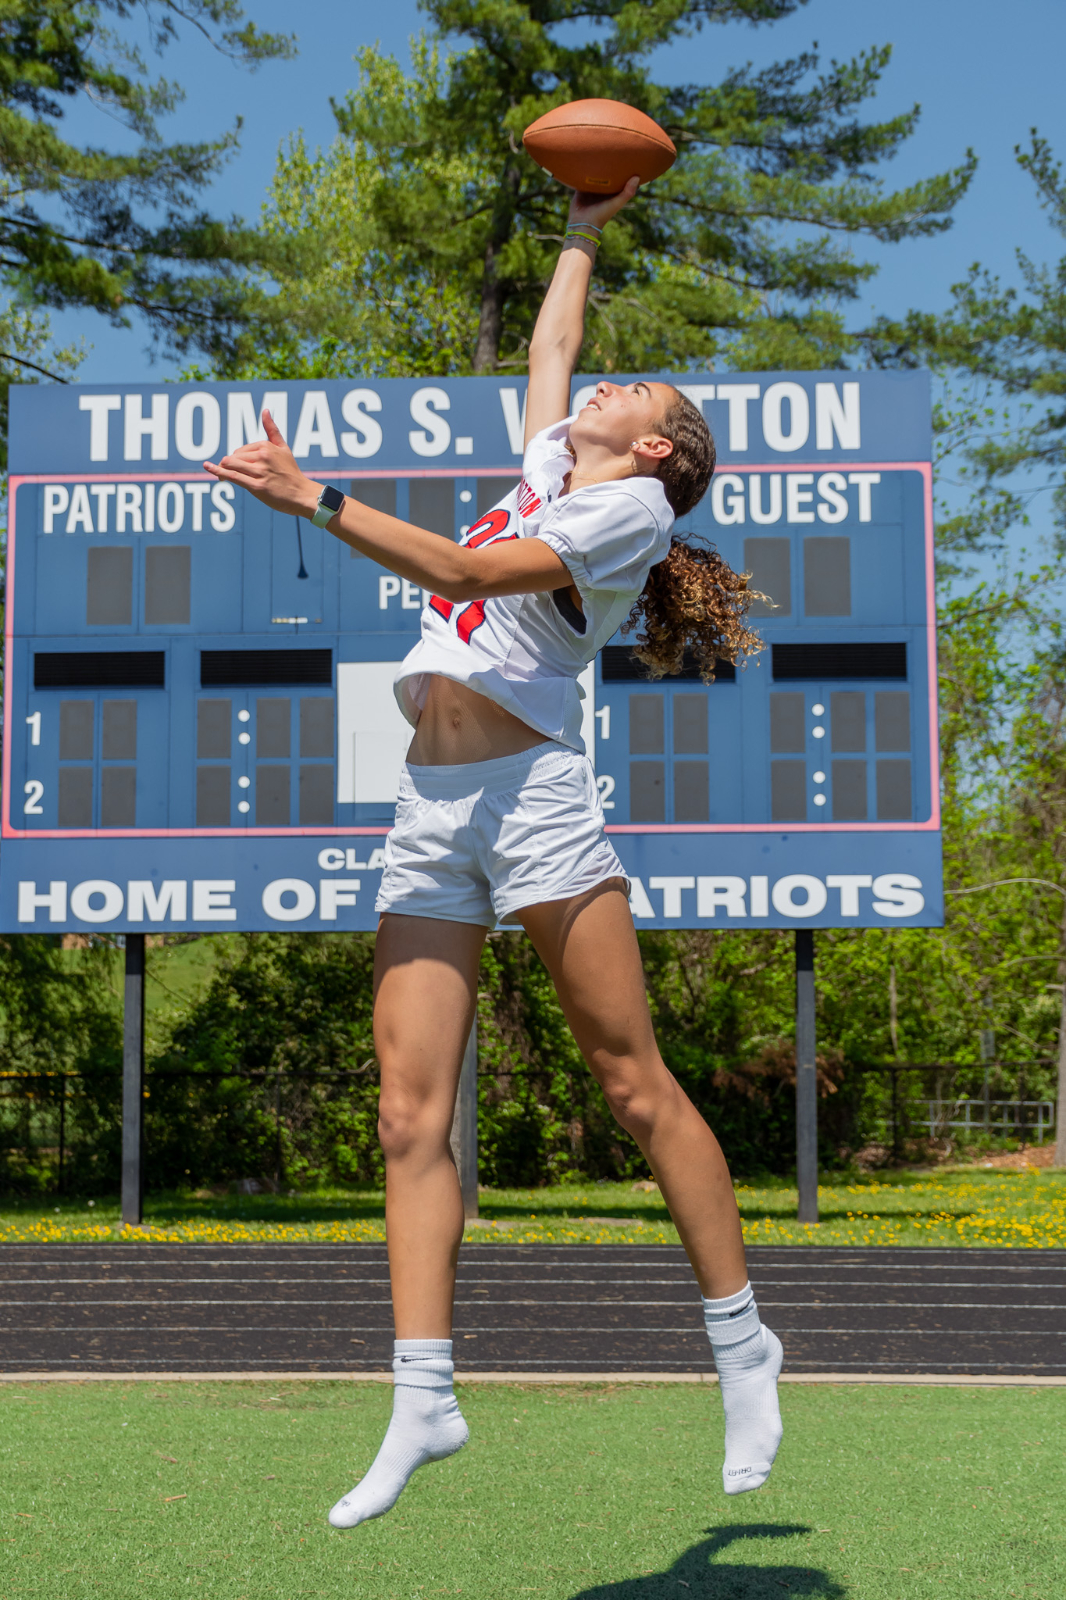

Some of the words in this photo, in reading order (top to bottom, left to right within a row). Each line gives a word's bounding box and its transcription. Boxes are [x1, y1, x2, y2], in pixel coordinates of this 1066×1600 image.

[79, 388, 383, 462] THOMAS
[409, 386, 474, 457] S.
[42, 481, 236, 534] PATRIOTS
[711, 472, 882, 526] GUEST
[26, 711, 42, 746] 1
[595, 704, 611, 740] 1
[23, 779, 44, 815] 2
[596, 774, 615, 810] 2
[18, 879, 237, 924] HOME
[262, 877, 361, 922] OF
[627, 873, 925, 920] ATRIOTS
